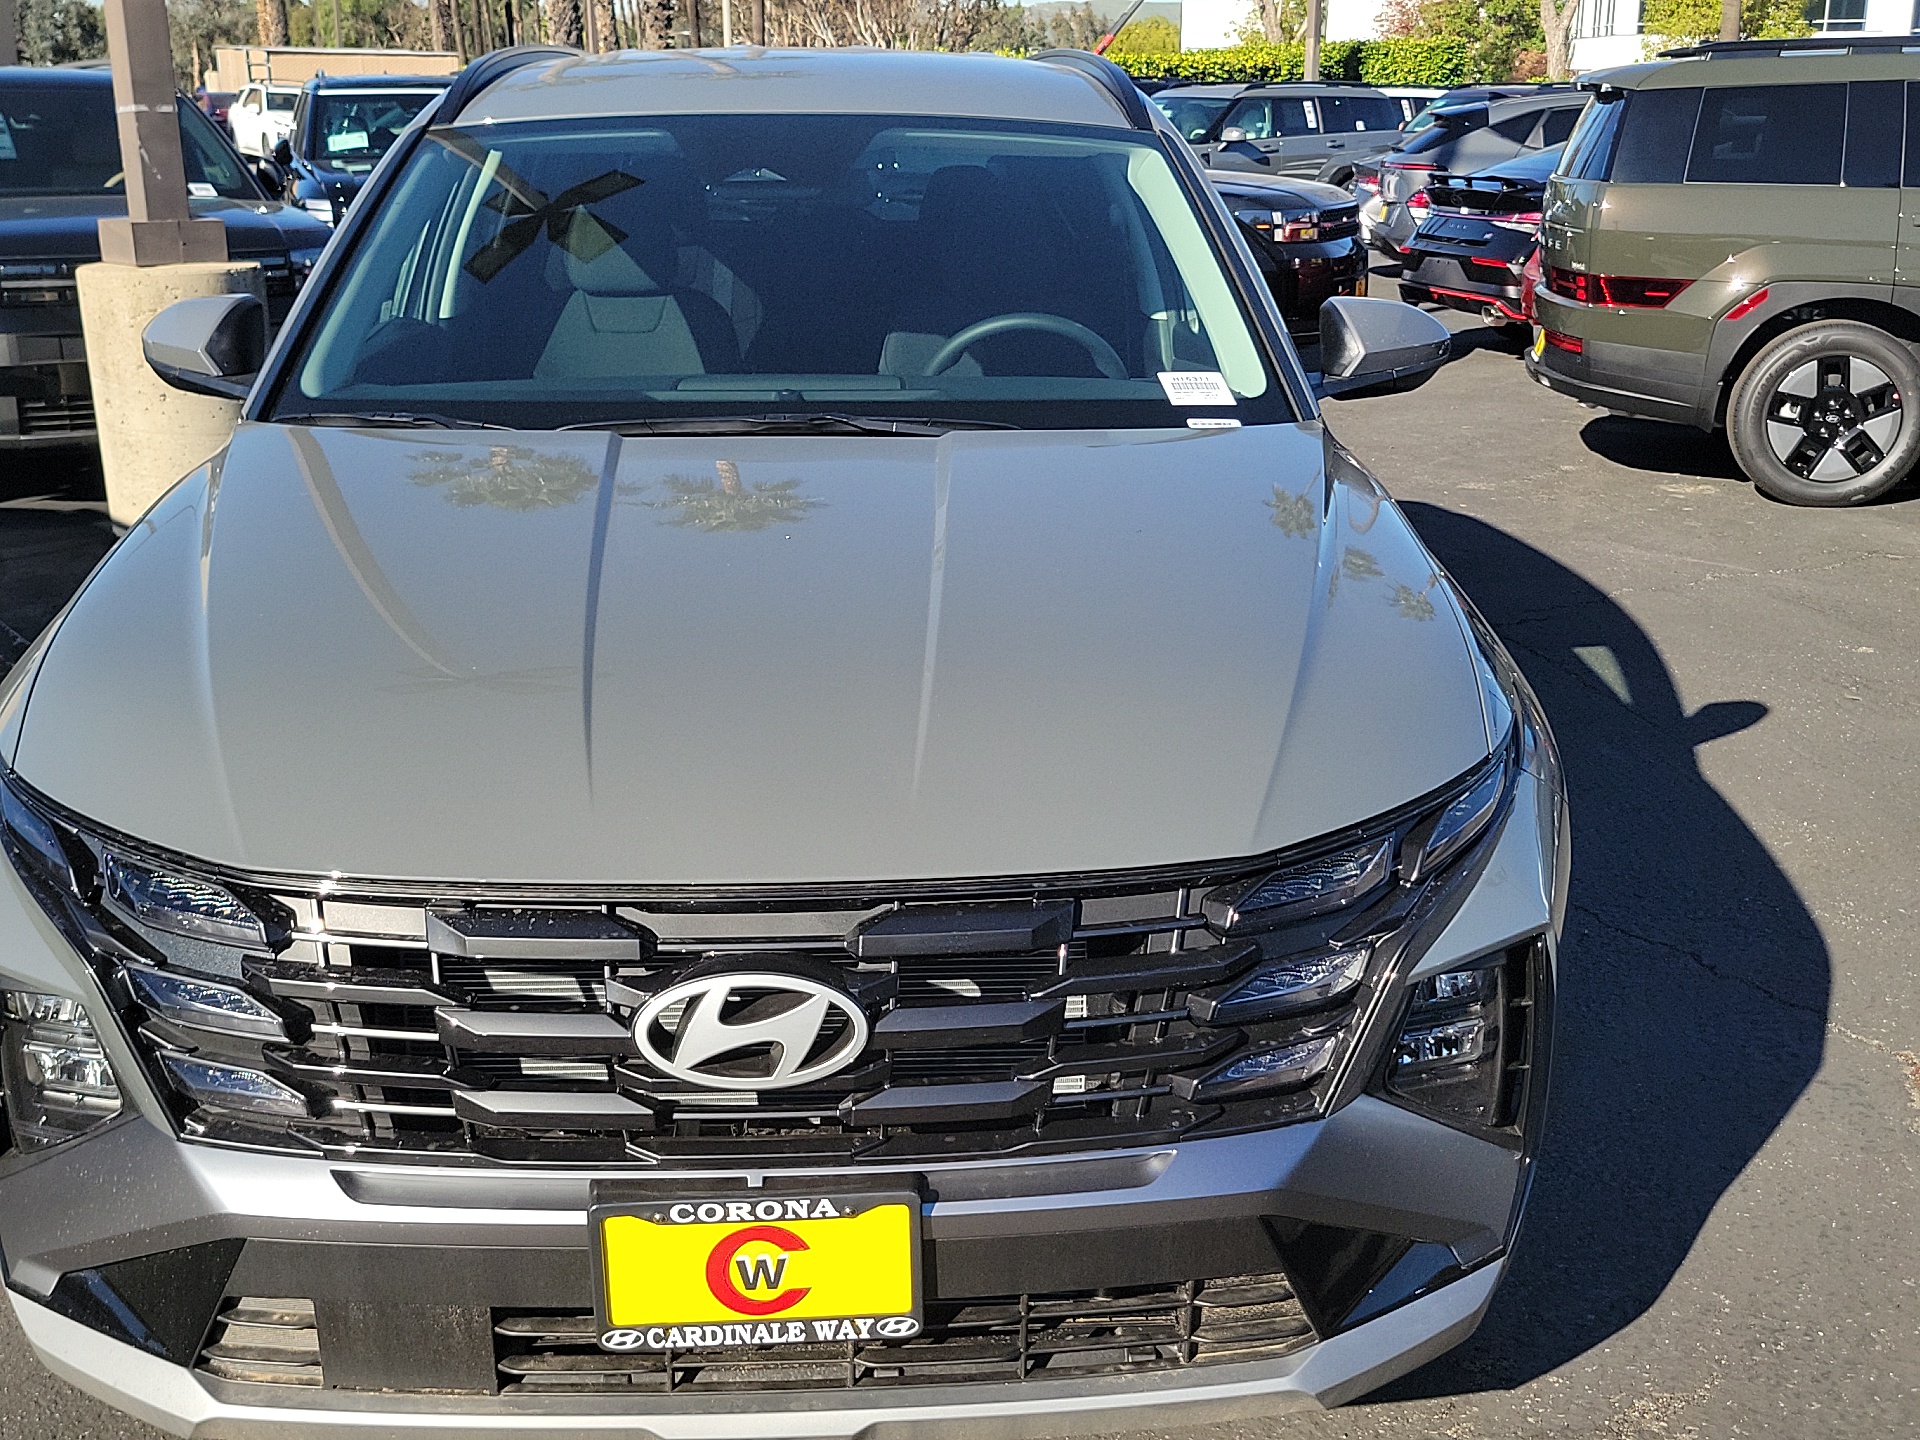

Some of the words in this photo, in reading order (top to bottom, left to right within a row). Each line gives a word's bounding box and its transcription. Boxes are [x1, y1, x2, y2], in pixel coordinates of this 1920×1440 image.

[669, 1198, 840, 1223] CORONA
[735, 1253, 789, 1290] W
[646, 1320, 807, 1349] CARDINALE
[812, 1317, 875, 1341] WAY
